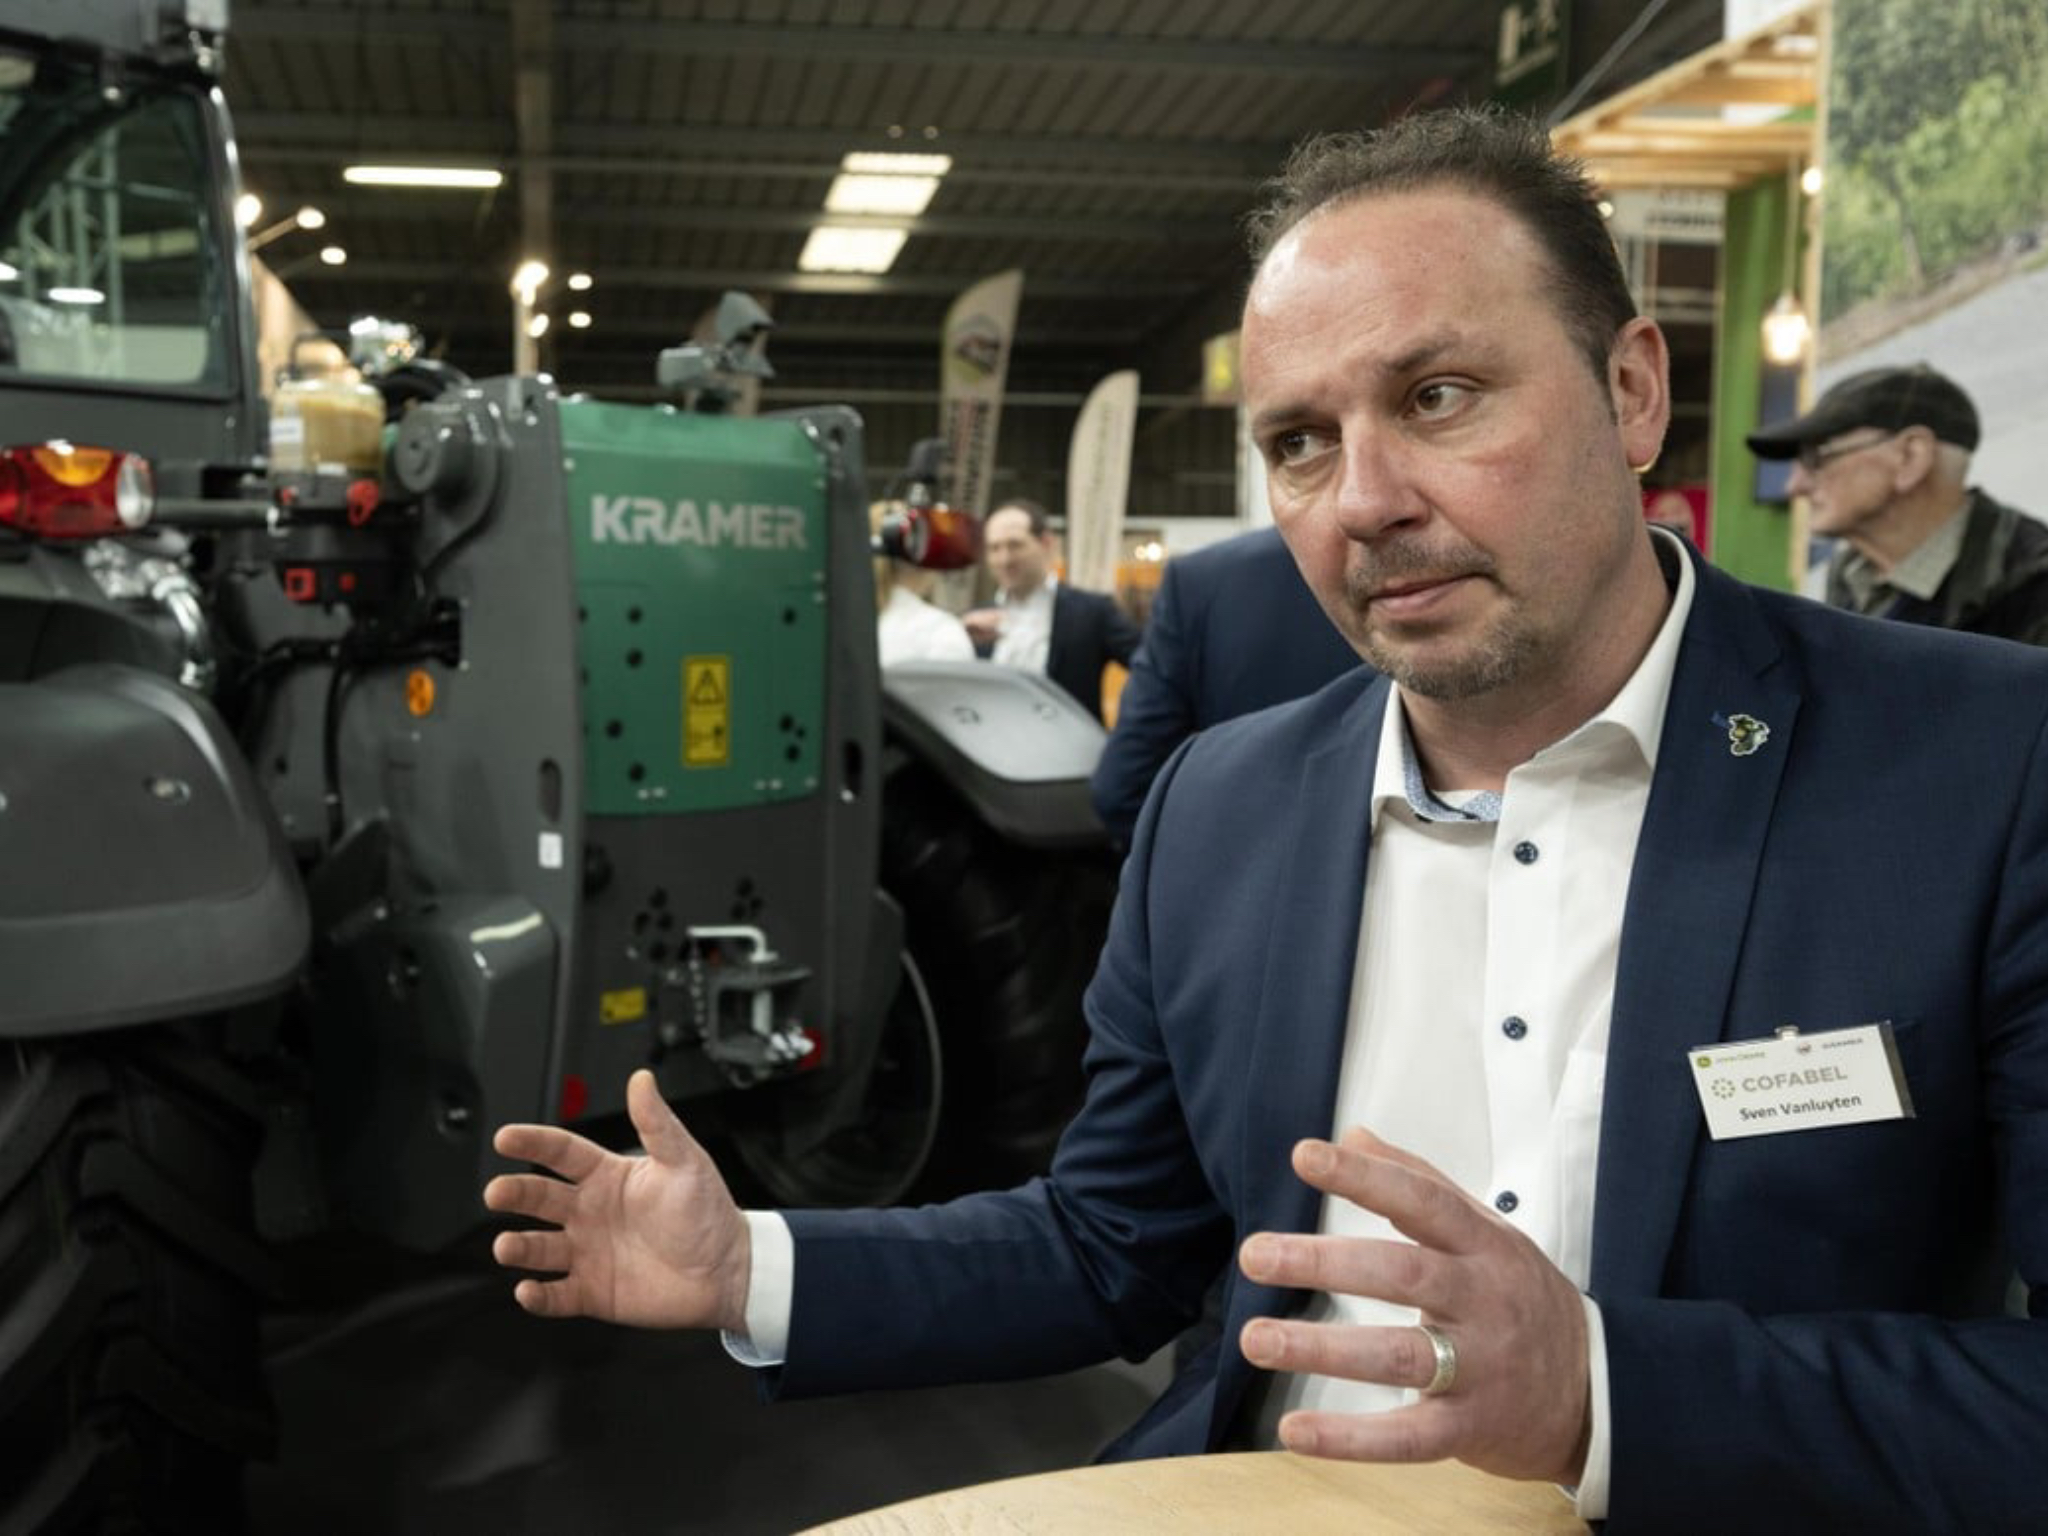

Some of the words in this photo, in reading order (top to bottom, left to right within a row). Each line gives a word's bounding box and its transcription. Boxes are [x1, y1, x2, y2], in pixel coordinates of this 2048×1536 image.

[591, 495, 807, 550] KRAMER
[1742, 1066, 1848, 1092] COFABEL
[1739, 1107, 1777, 1121] Sven
[1780, 1095, 1861, 1115] Vanluyten
